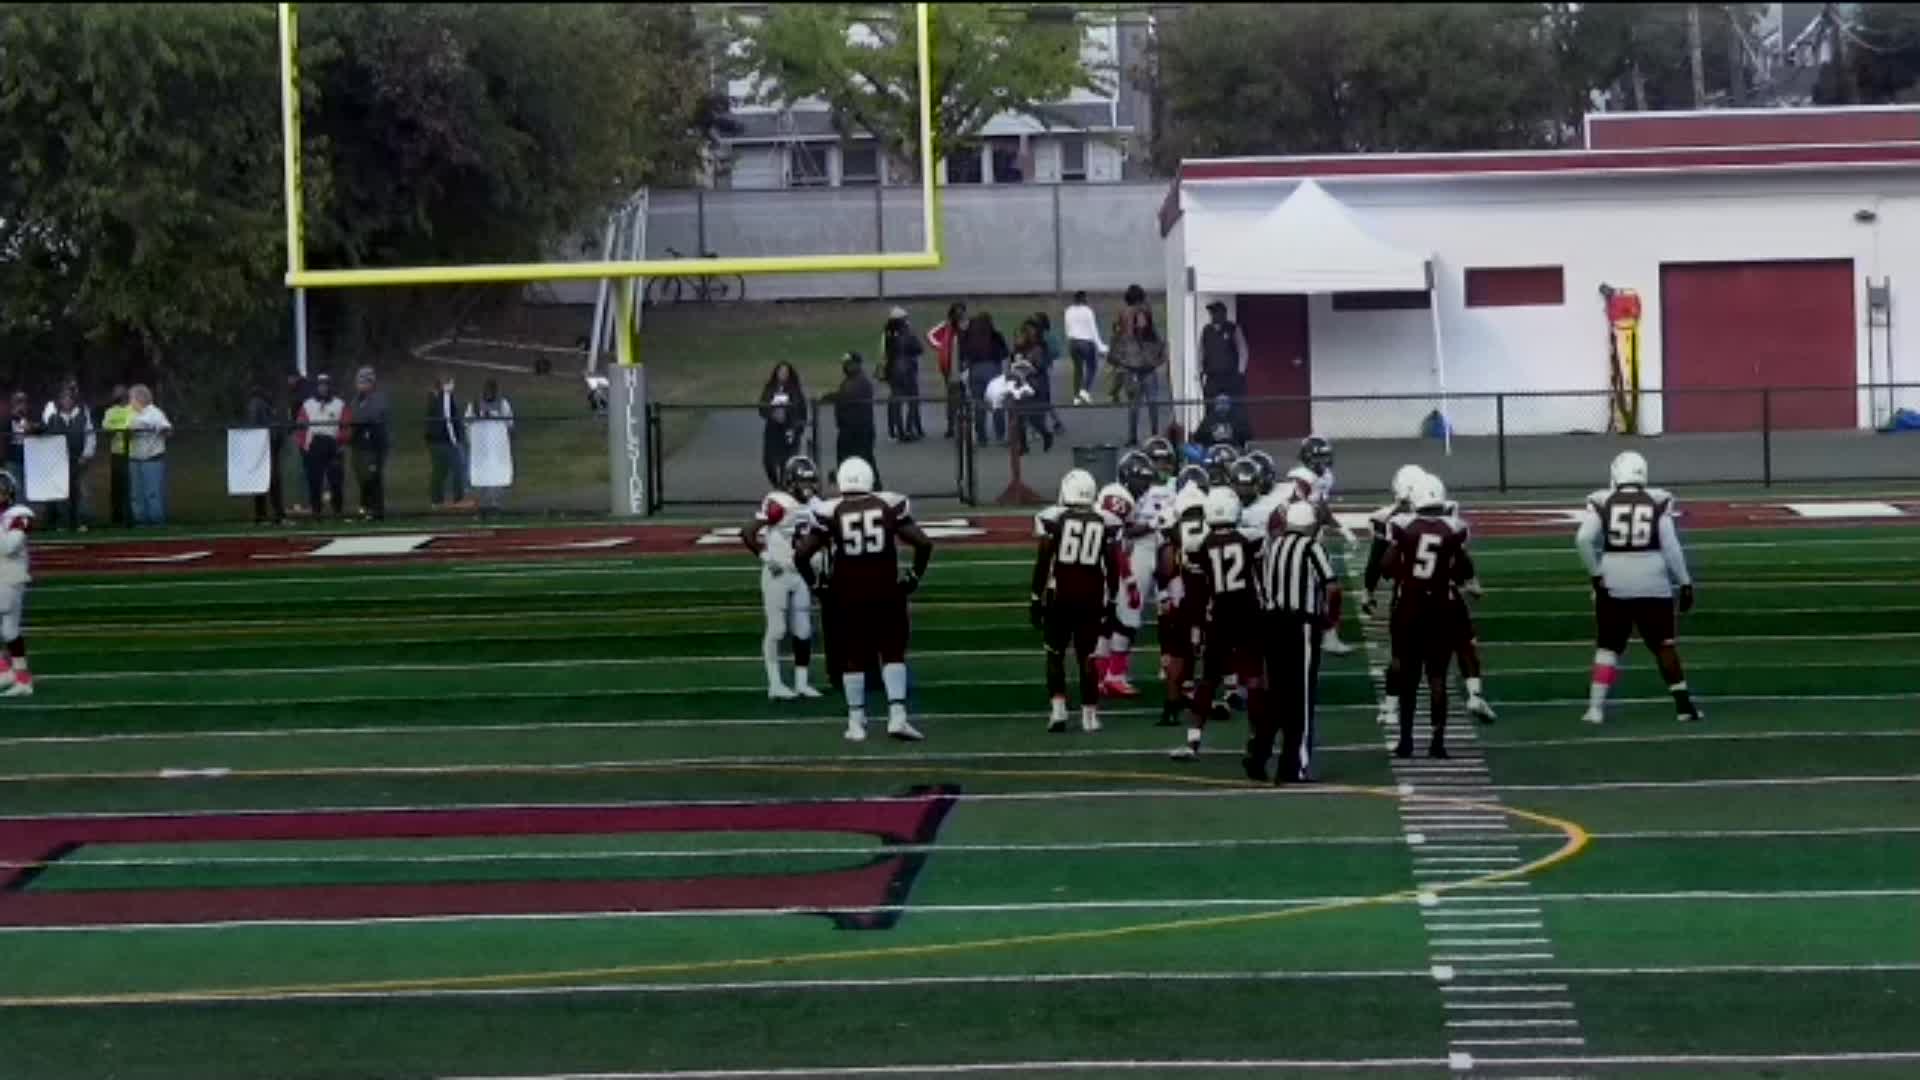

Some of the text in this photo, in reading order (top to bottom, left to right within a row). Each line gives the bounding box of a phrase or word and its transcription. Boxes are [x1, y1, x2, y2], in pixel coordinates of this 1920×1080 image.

[840, 509, 885, 555] 55
[1057, 518, 1104, 565] 60
[1608, 503, 1654, 547] 56
[1207, 543, 1247, 593] 12
[1412, 533, 1443, 579] 5
